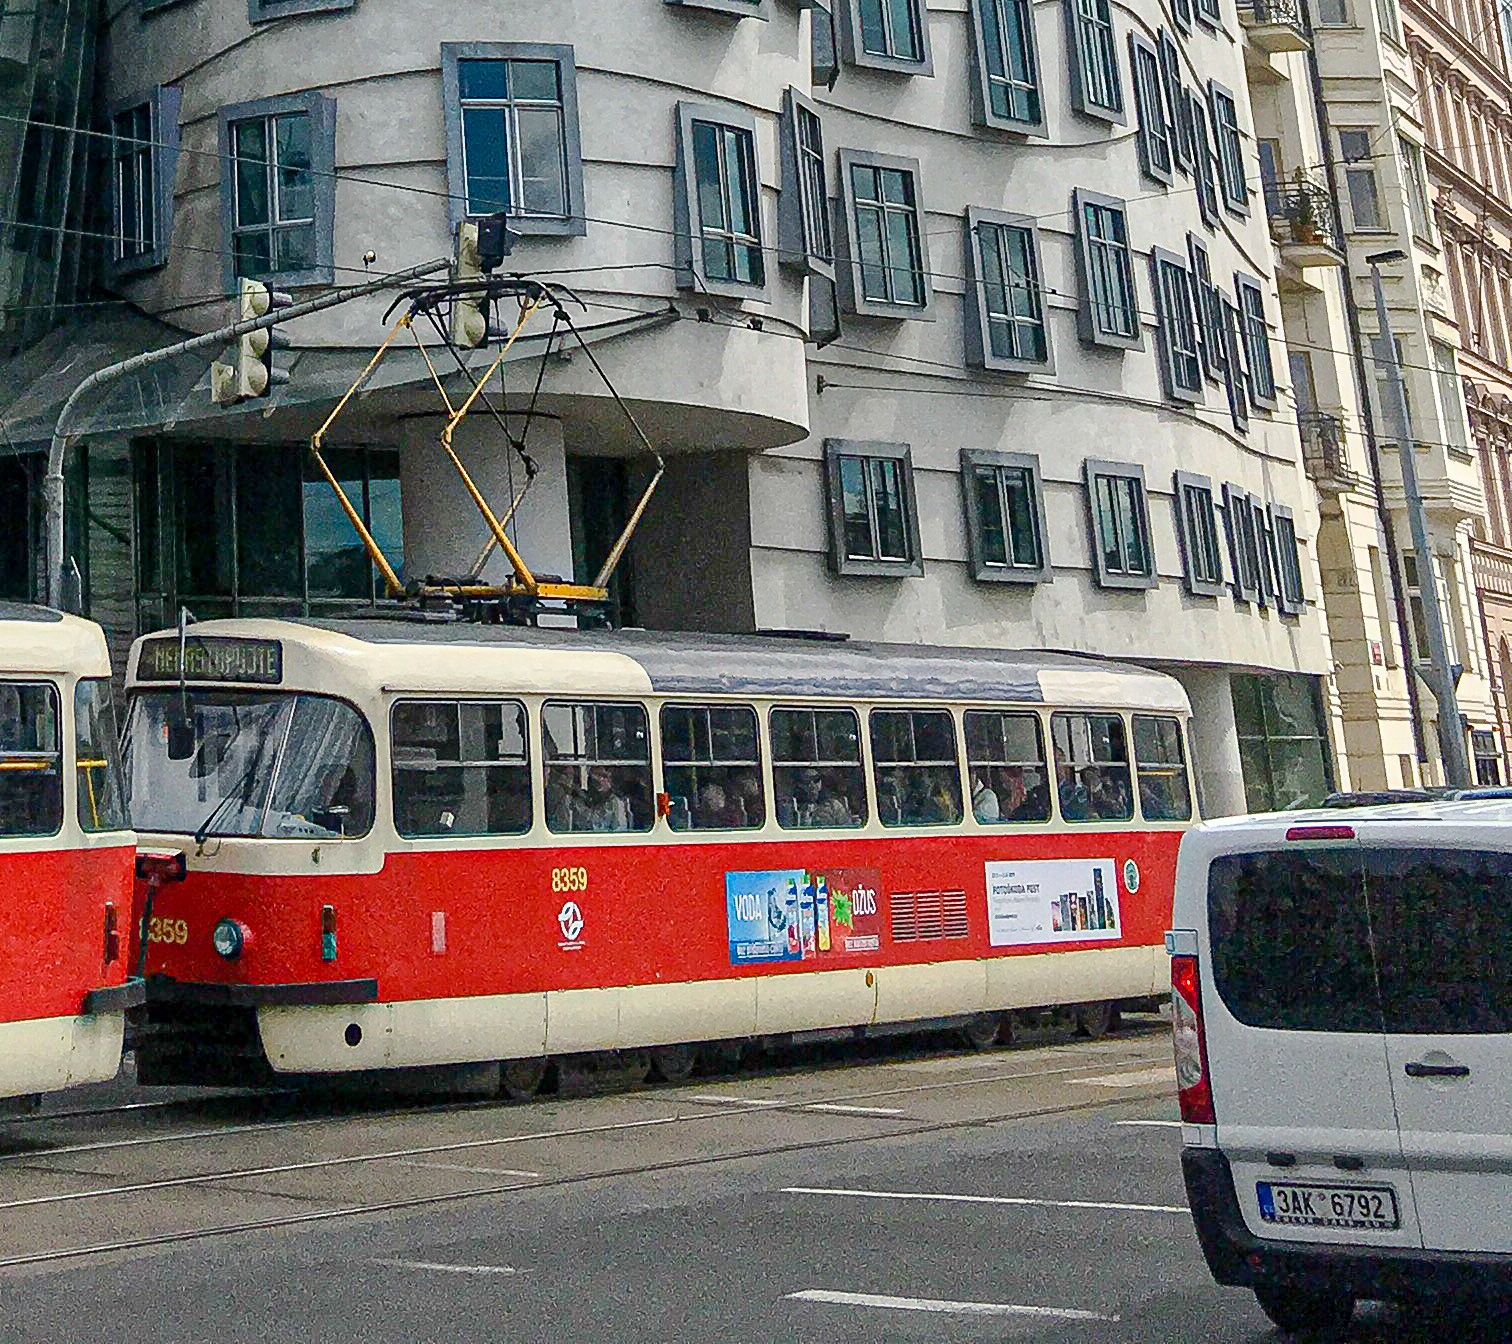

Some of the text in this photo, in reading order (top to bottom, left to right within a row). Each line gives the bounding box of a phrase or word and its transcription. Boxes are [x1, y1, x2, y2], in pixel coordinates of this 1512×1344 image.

[551, 867, 588, 892] 8359
[734, 893, 762, 921] VODA
[1276, 1189, 1386, 1220] 3AK 6792
